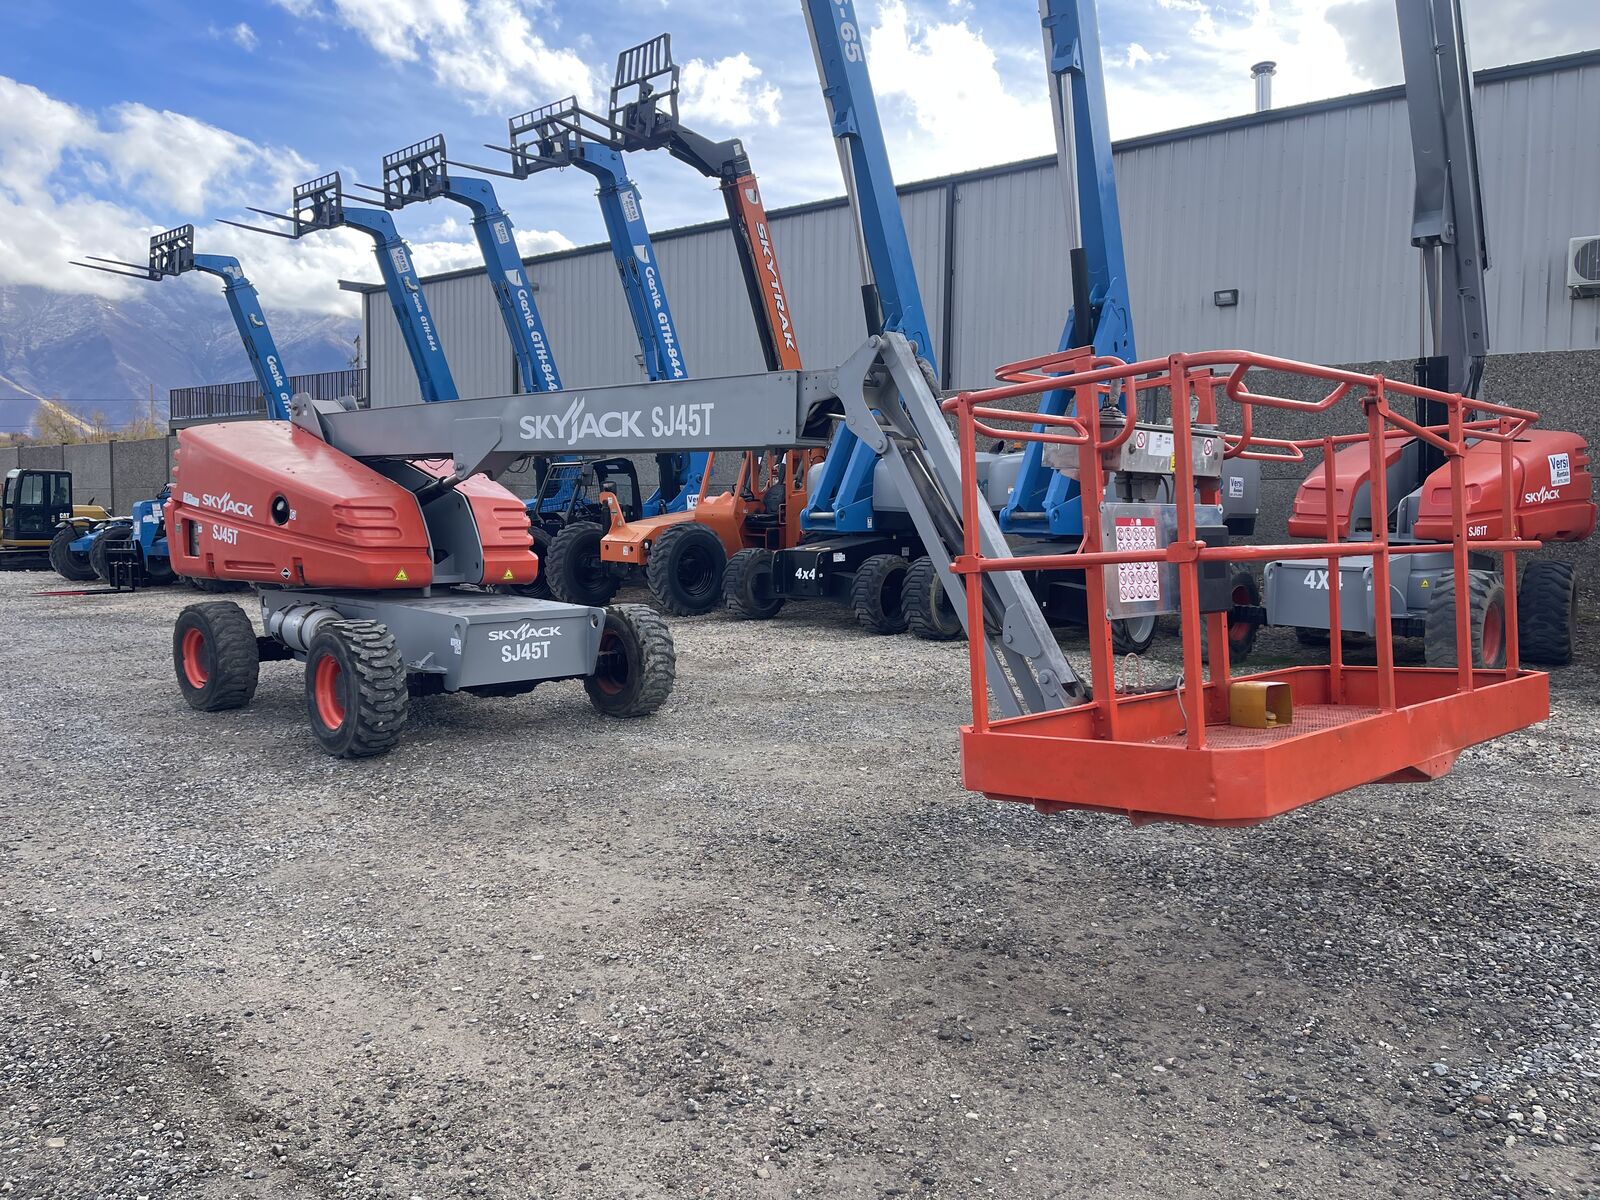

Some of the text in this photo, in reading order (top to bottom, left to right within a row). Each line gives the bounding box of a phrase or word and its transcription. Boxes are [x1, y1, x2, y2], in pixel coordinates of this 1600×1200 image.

[834, 0, 862, 62] -65
[755, 221, 796, 352] SKYTRAK
[420, 315, 437, 351] GTH-844
[645, 266, 684, 379] Genie GTH-844
[517, 288, 558, 392] Genie GTH-844
[266, 355, 283, 388] Genie
[519, 396, 715, 446] SKYJACK SJ45T
[1550, 455, 1569, 470] Versi
[202, 491, 254, 518] SKYJACK
[1524, 486, 1561, 503] SKYJACK
[212, 524, 239, 545] SJ45T
[1468, 525, 1488, 537] SJ61T
[795, 567, 816, 580] 4x4
[488, 623, 563, 641] SKYJACK
[501, 641, 551, 663] SJ45T
